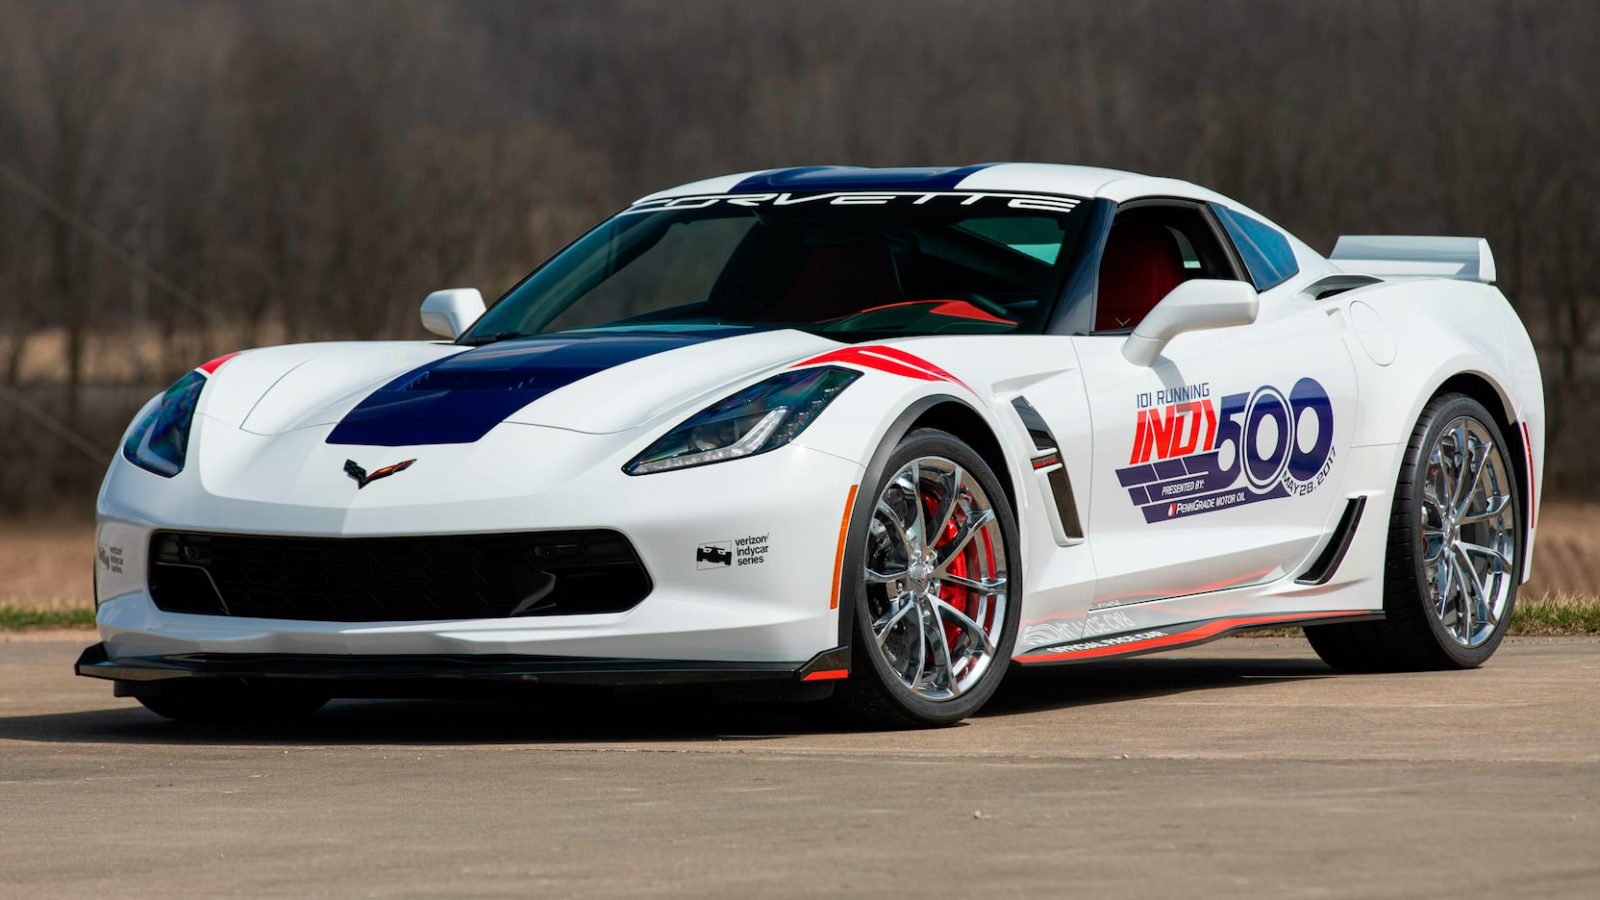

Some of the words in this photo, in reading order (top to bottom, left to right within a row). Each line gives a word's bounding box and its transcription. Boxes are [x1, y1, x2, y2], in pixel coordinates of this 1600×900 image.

[620, 191, 1081, 215] CORVETTE
[1157, 382, 1210, 405] RUNNING
[1129, 399, 1217, 465] INDY
[1214, 377, 1334, 491] 500
[1161, 481, 1195, 496] PRESENTED
[1215, 494, 1236, 506] MOTOR
[1236, 492, 1246, 502] OIL
[735, 535, 767, 546] verizon
[736, 545, 769, 557] indycar
[737, 556, 764, 566] series
